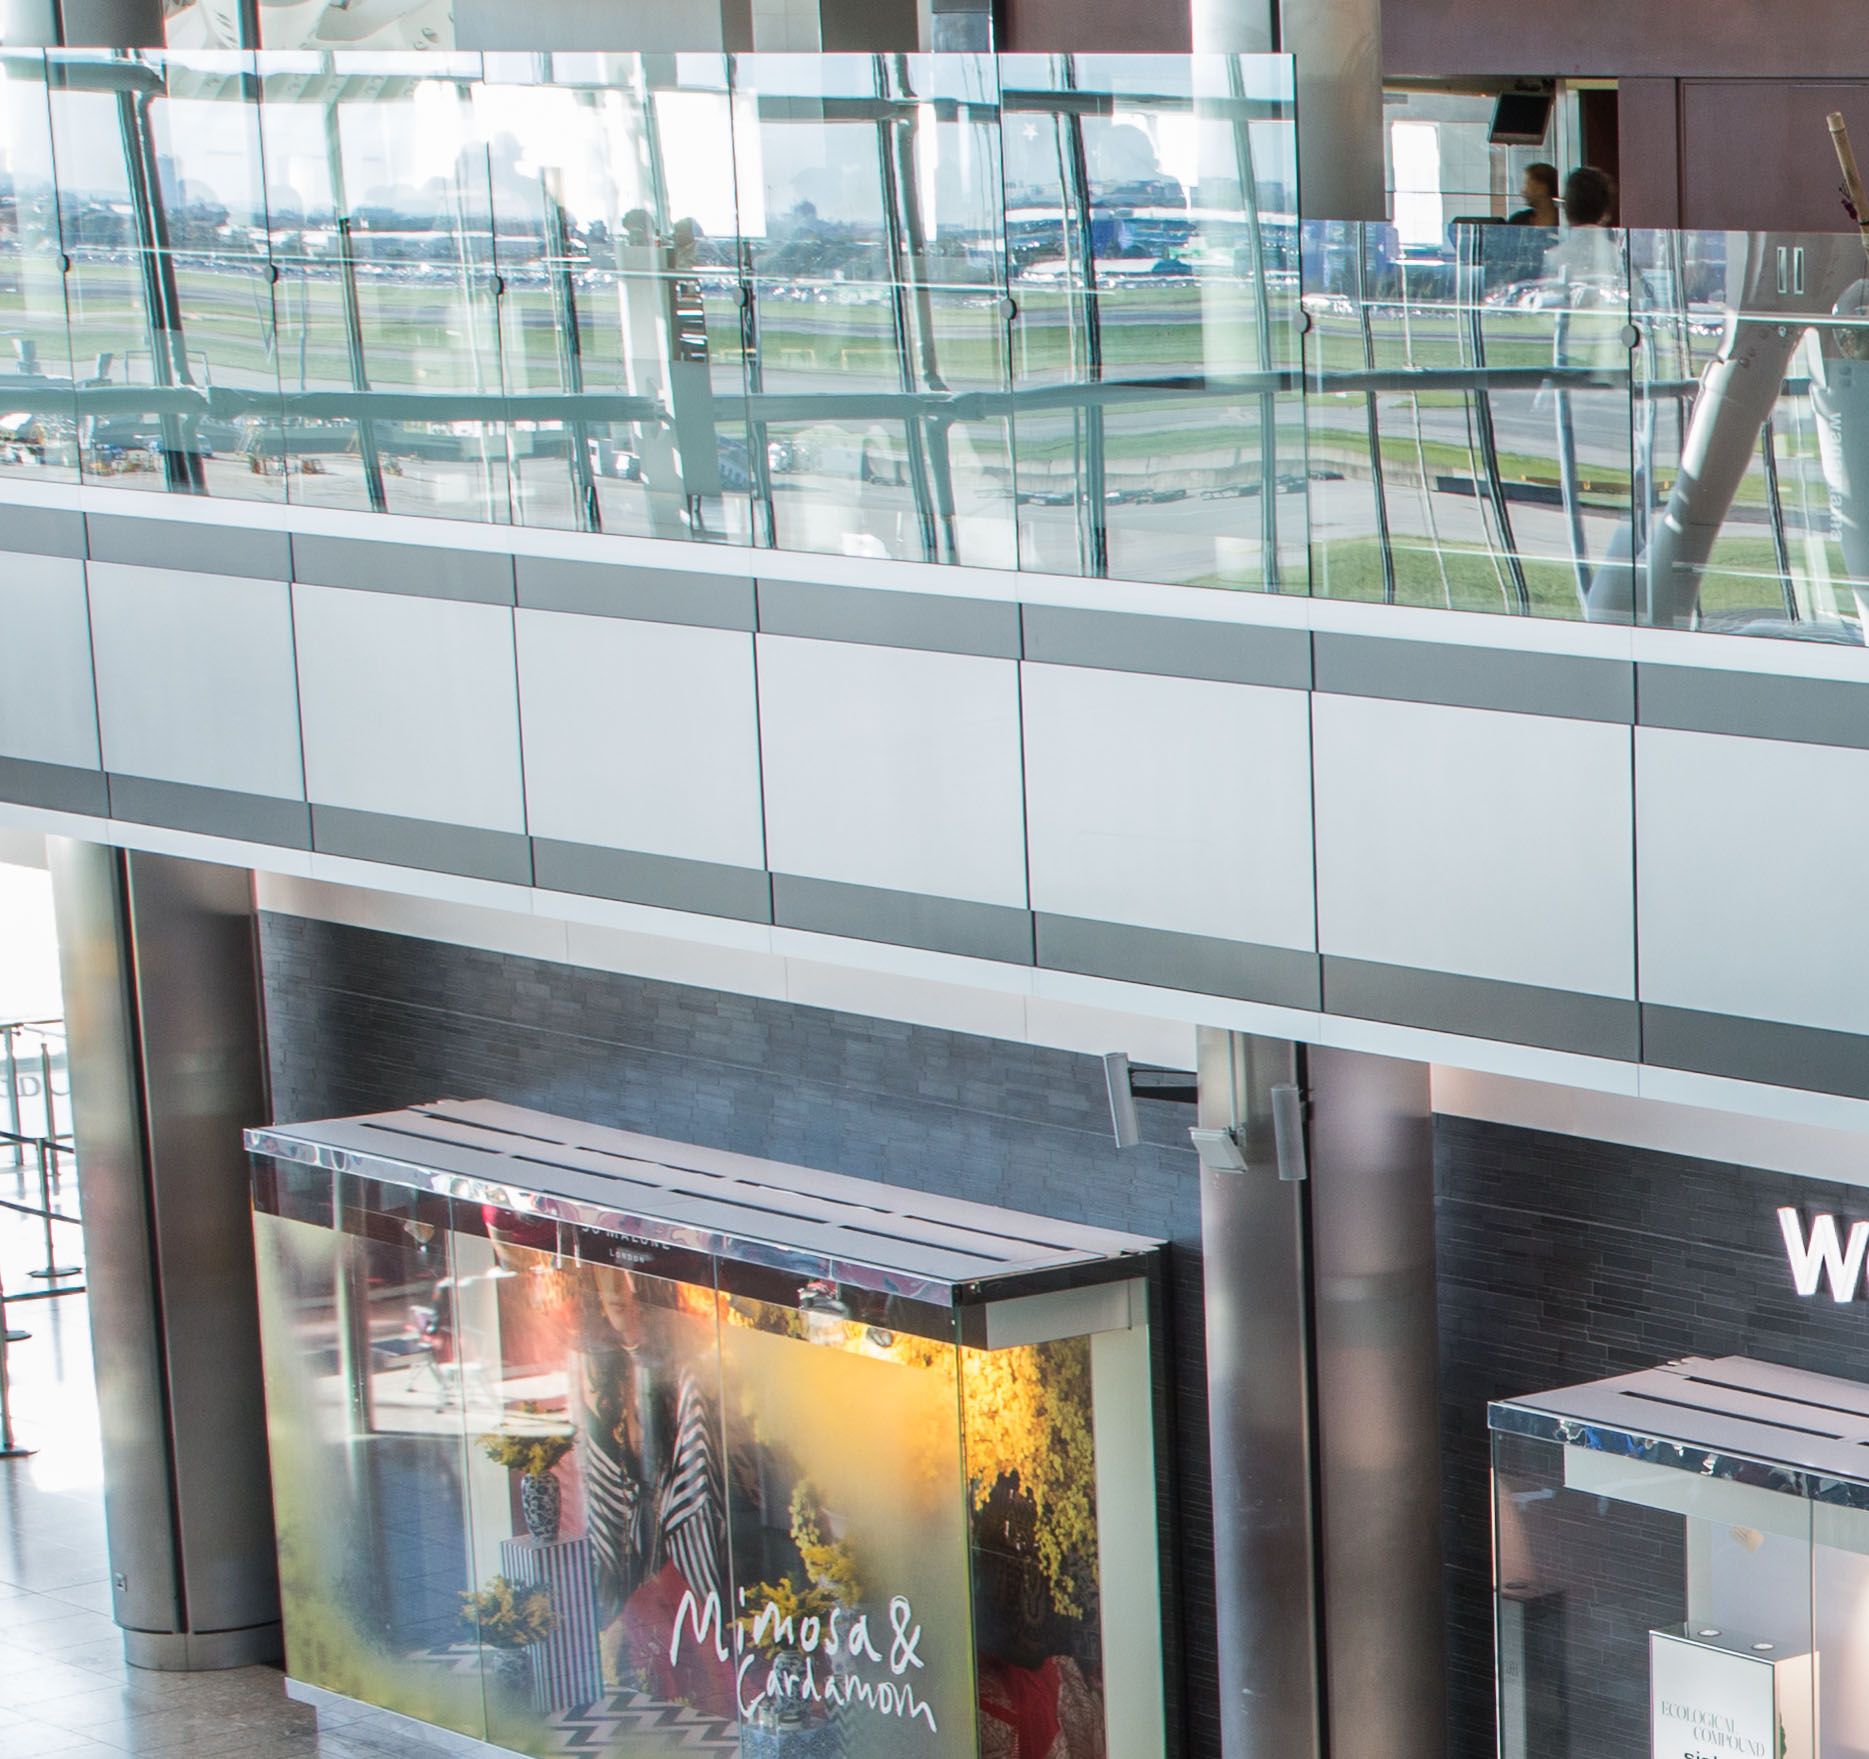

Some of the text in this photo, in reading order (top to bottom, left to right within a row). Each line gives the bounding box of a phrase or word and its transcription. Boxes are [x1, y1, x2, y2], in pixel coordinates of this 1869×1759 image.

[669, 1586, 925, 1676] Mimosa &
[1661, 1700, 1738, 1735] ECOLOGICAL
[1693, 1726, 1766, 1758] COMPOUND
